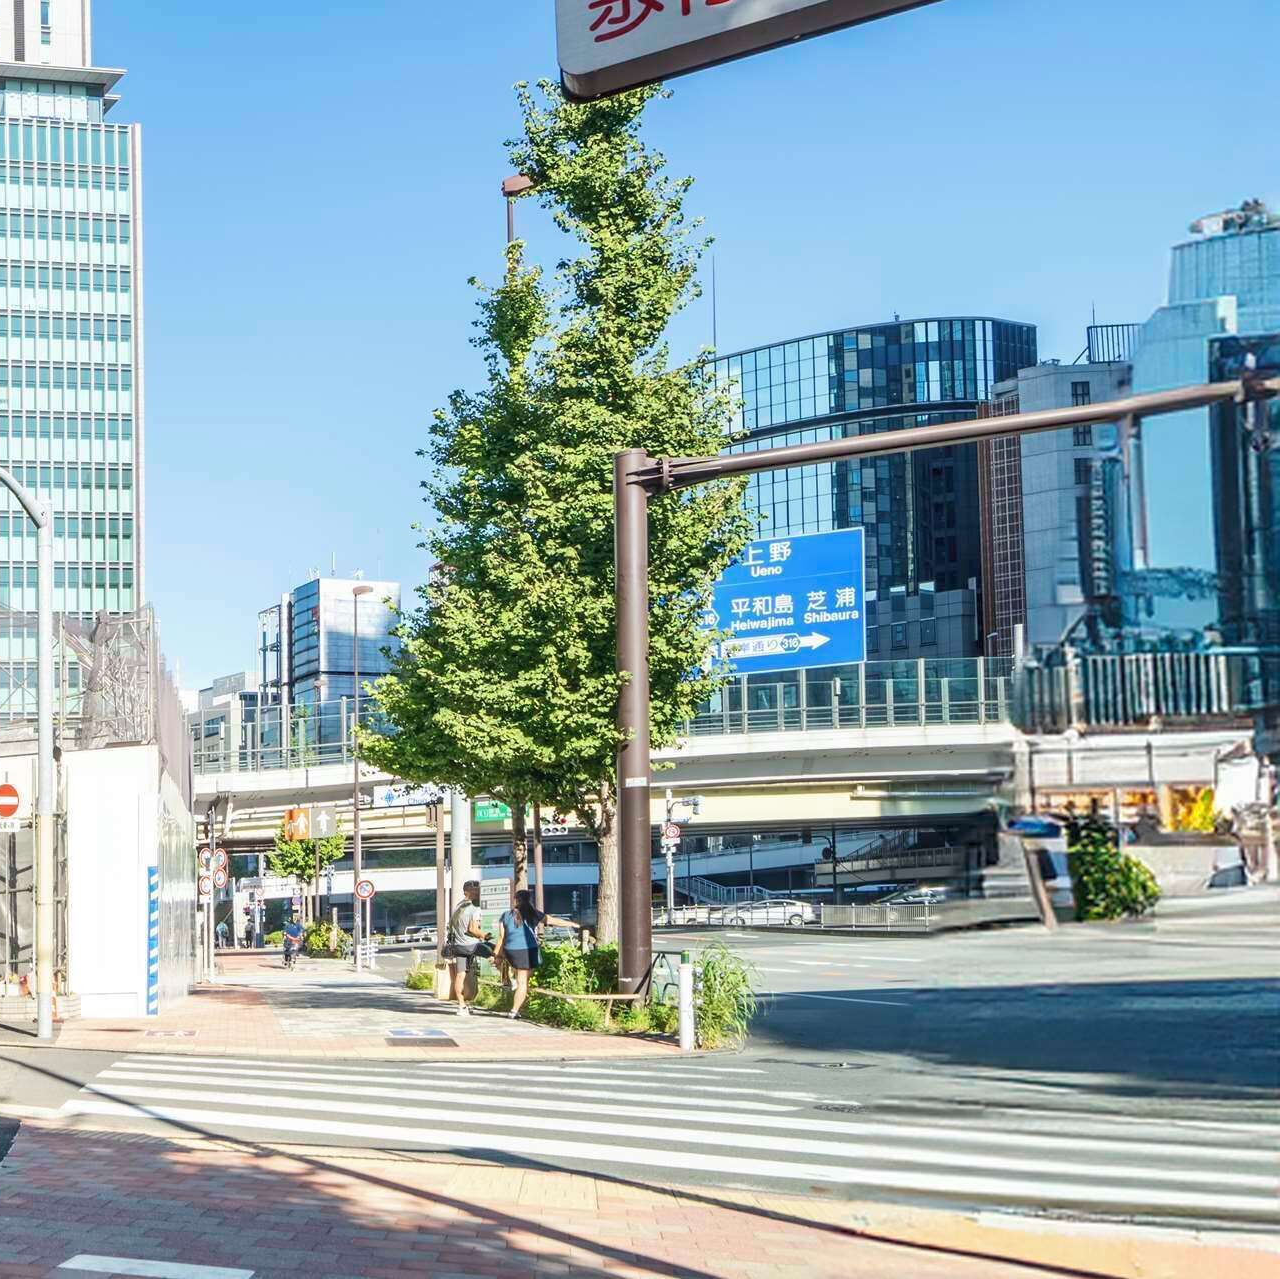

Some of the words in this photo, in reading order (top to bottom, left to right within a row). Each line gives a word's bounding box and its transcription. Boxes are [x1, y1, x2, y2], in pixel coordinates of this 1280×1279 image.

[742, 541, 791, 566] 上野
[751, 566, 782, 577] Ueno
[731, 594, 794, 618] 平和島
[807, 587, 856, 611] 芝浦
[731, 616, 794, 631] Heiwajima
[804, 609, 859, 624] Shibaura
[782, 638, 799, 649] 316
